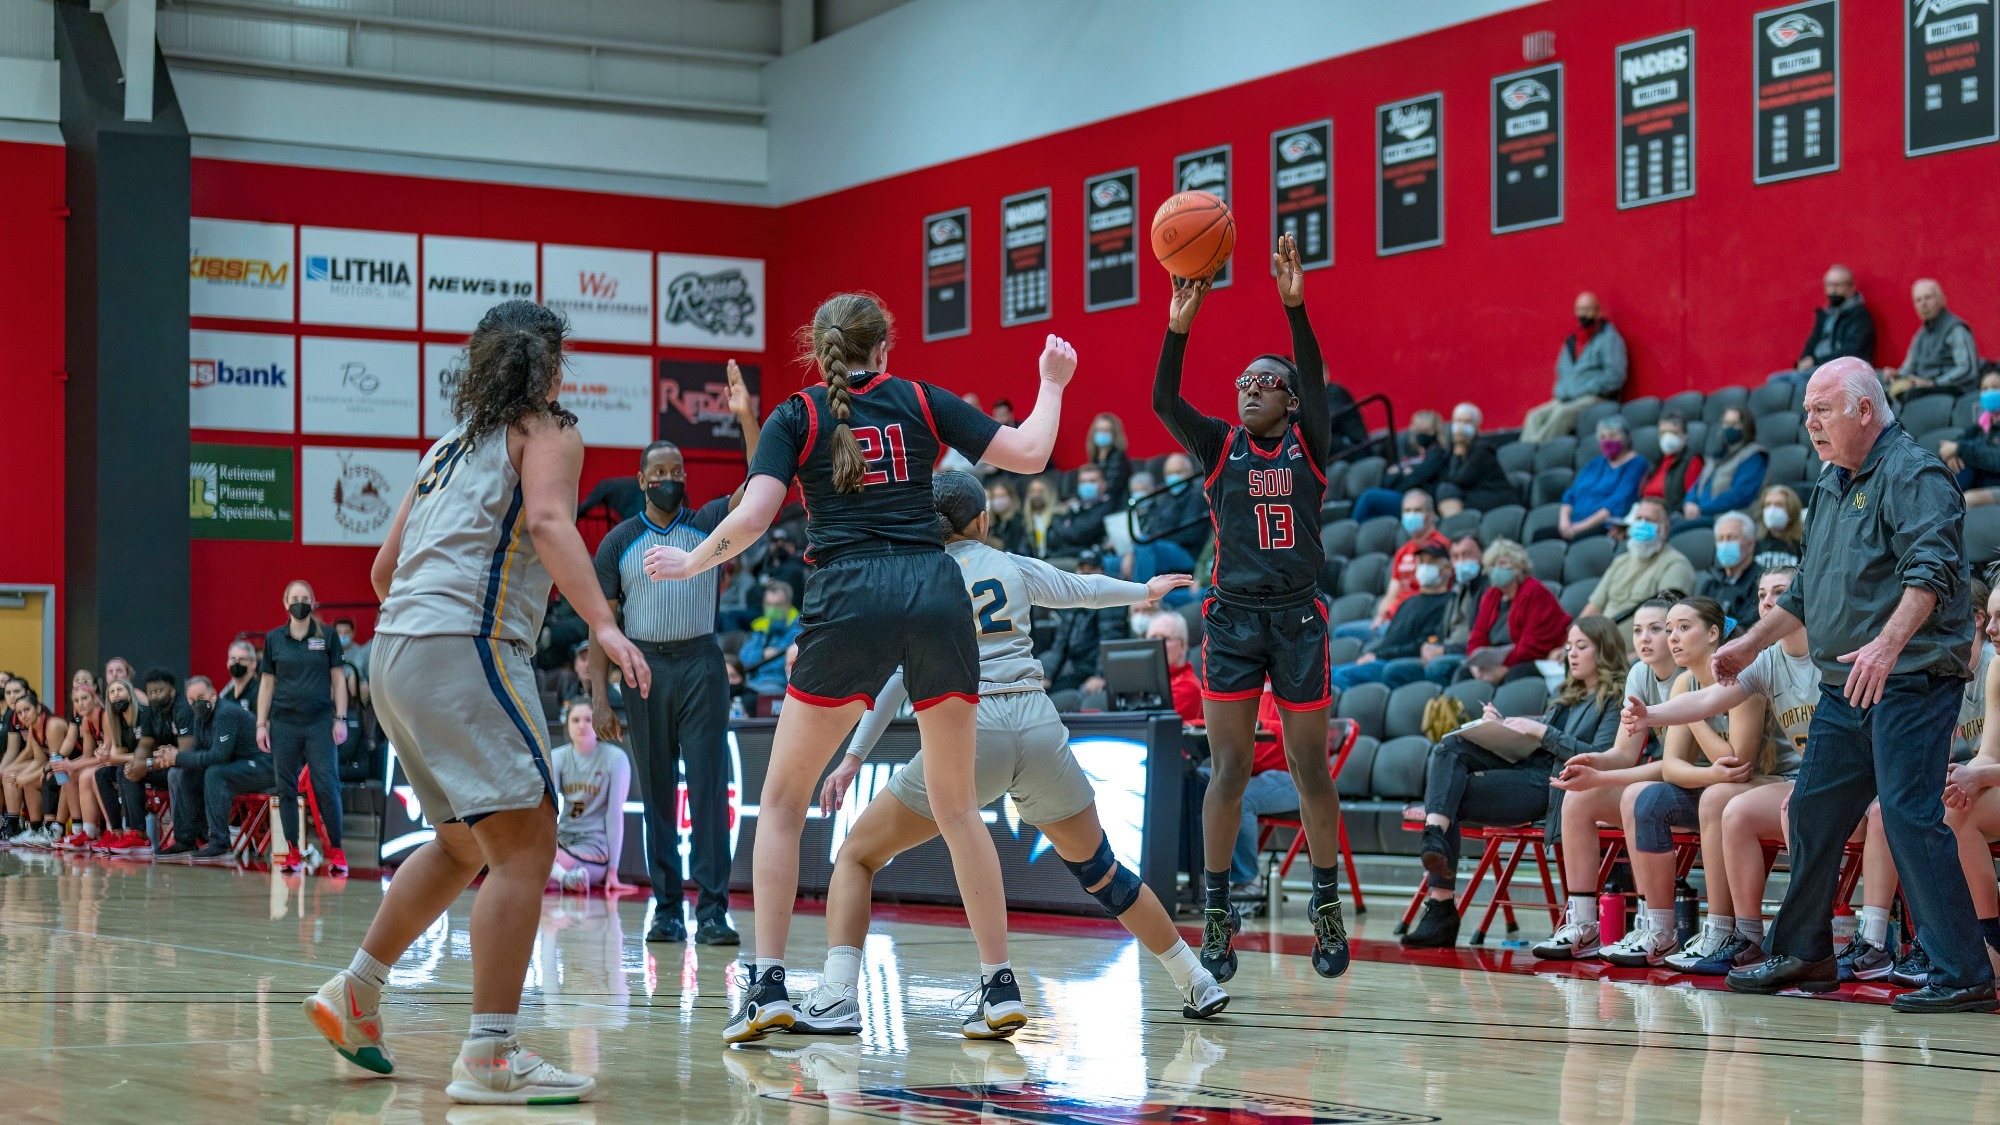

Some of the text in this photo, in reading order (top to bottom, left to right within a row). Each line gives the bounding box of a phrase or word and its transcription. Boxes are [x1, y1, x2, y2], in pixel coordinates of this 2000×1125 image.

[1622, 45, 1688, 85] RAIDERS
[331, 258, 411, 285] LITHIA
[428, 275, 532, 297] NEWS 10
[417, 436, 471, 497] 31
[850, 423, 910, 486] 21
[219, 464, 276, 483] Retirement
[1248, 468, 1293, 497] SOU
[219, 485, 265, 504] Planning
[219, 503, 277, 522] Specialists,
[1254, 503, 1295, 550] 13
